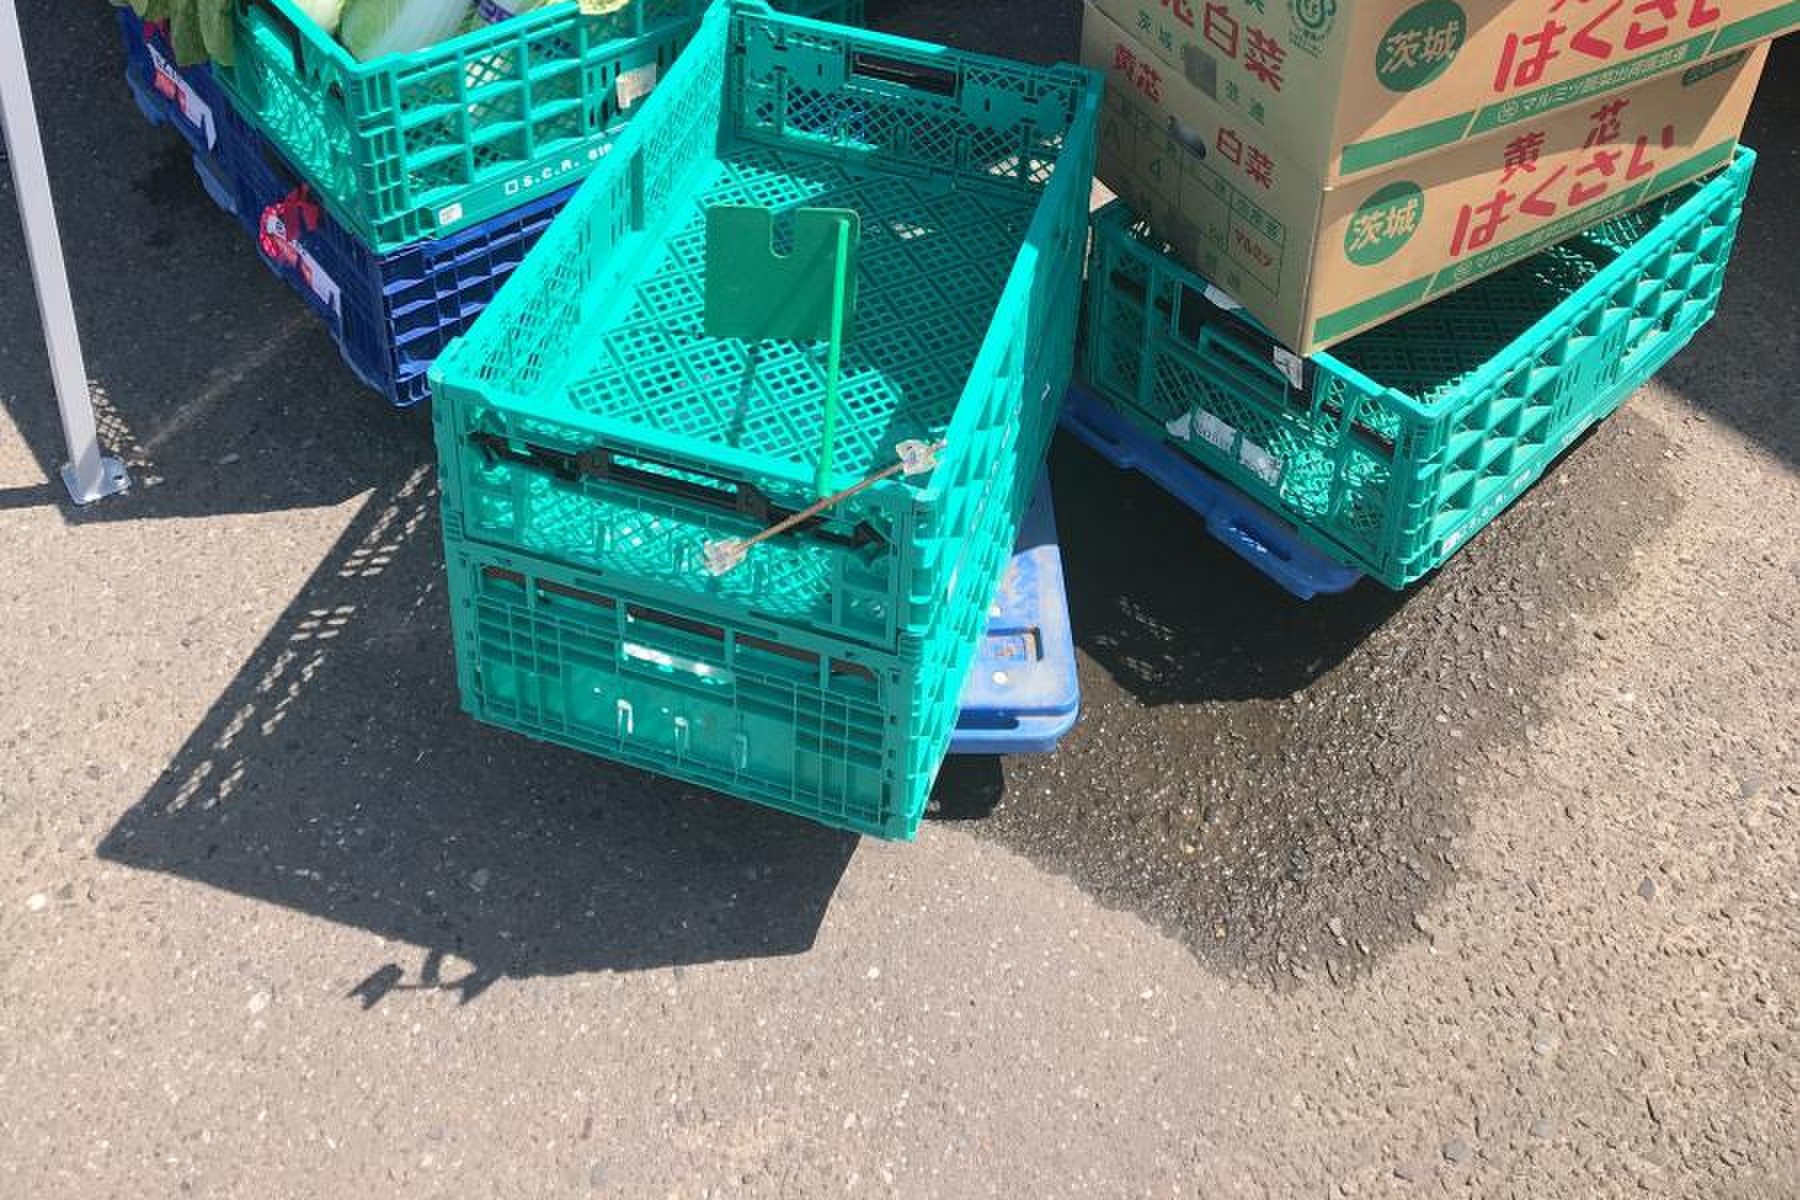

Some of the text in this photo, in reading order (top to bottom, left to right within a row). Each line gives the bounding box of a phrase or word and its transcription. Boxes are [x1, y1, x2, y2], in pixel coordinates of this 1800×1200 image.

[1380, 18, 1460, 74] 茨城
[1449, 124, 1675, 257] はくさい
[1349, 198, 1419, 251] 茨城
